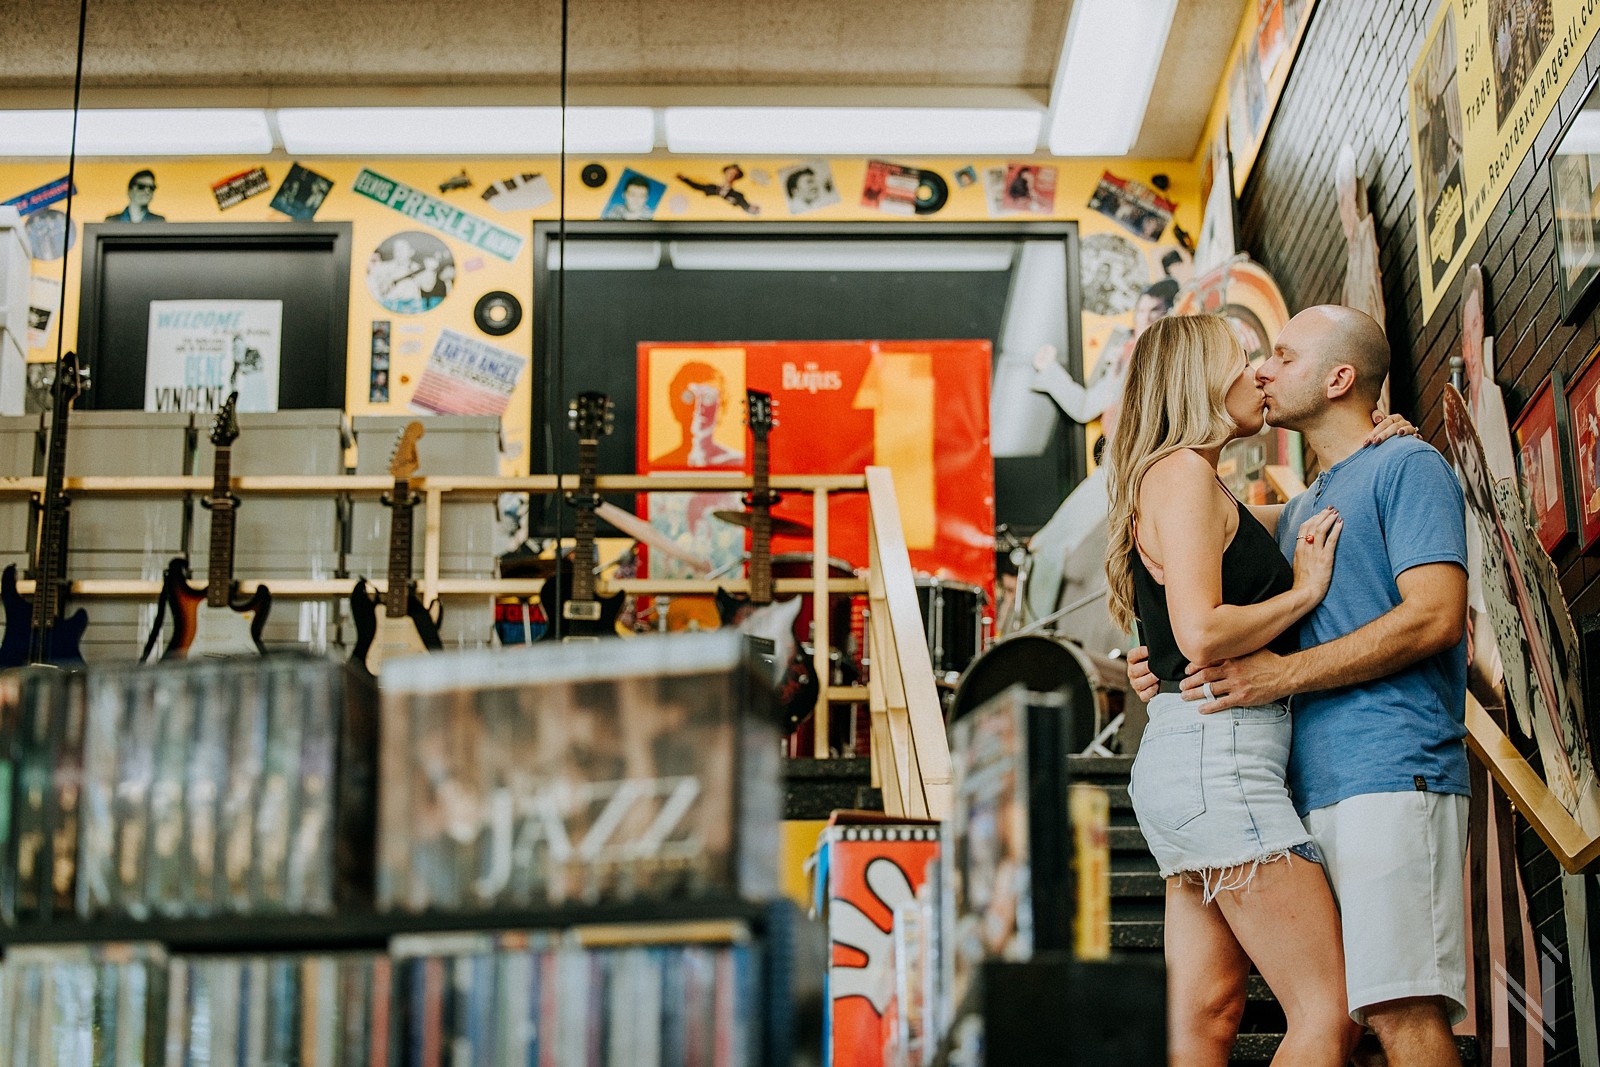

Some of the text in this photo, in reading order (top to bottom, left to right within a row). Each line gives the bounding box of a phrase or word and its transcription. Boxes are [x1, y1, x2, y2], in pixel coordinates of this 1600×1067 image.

[1464, 24, 1481, 73] Sell
[1466, 76, 1491, 132] Trade
[1468, 0, 1600, 225] www.Recordexchangestl.co
[387, 184, 487, 246] PRESLEY
[157, 308, 244, 329] WELCOME
